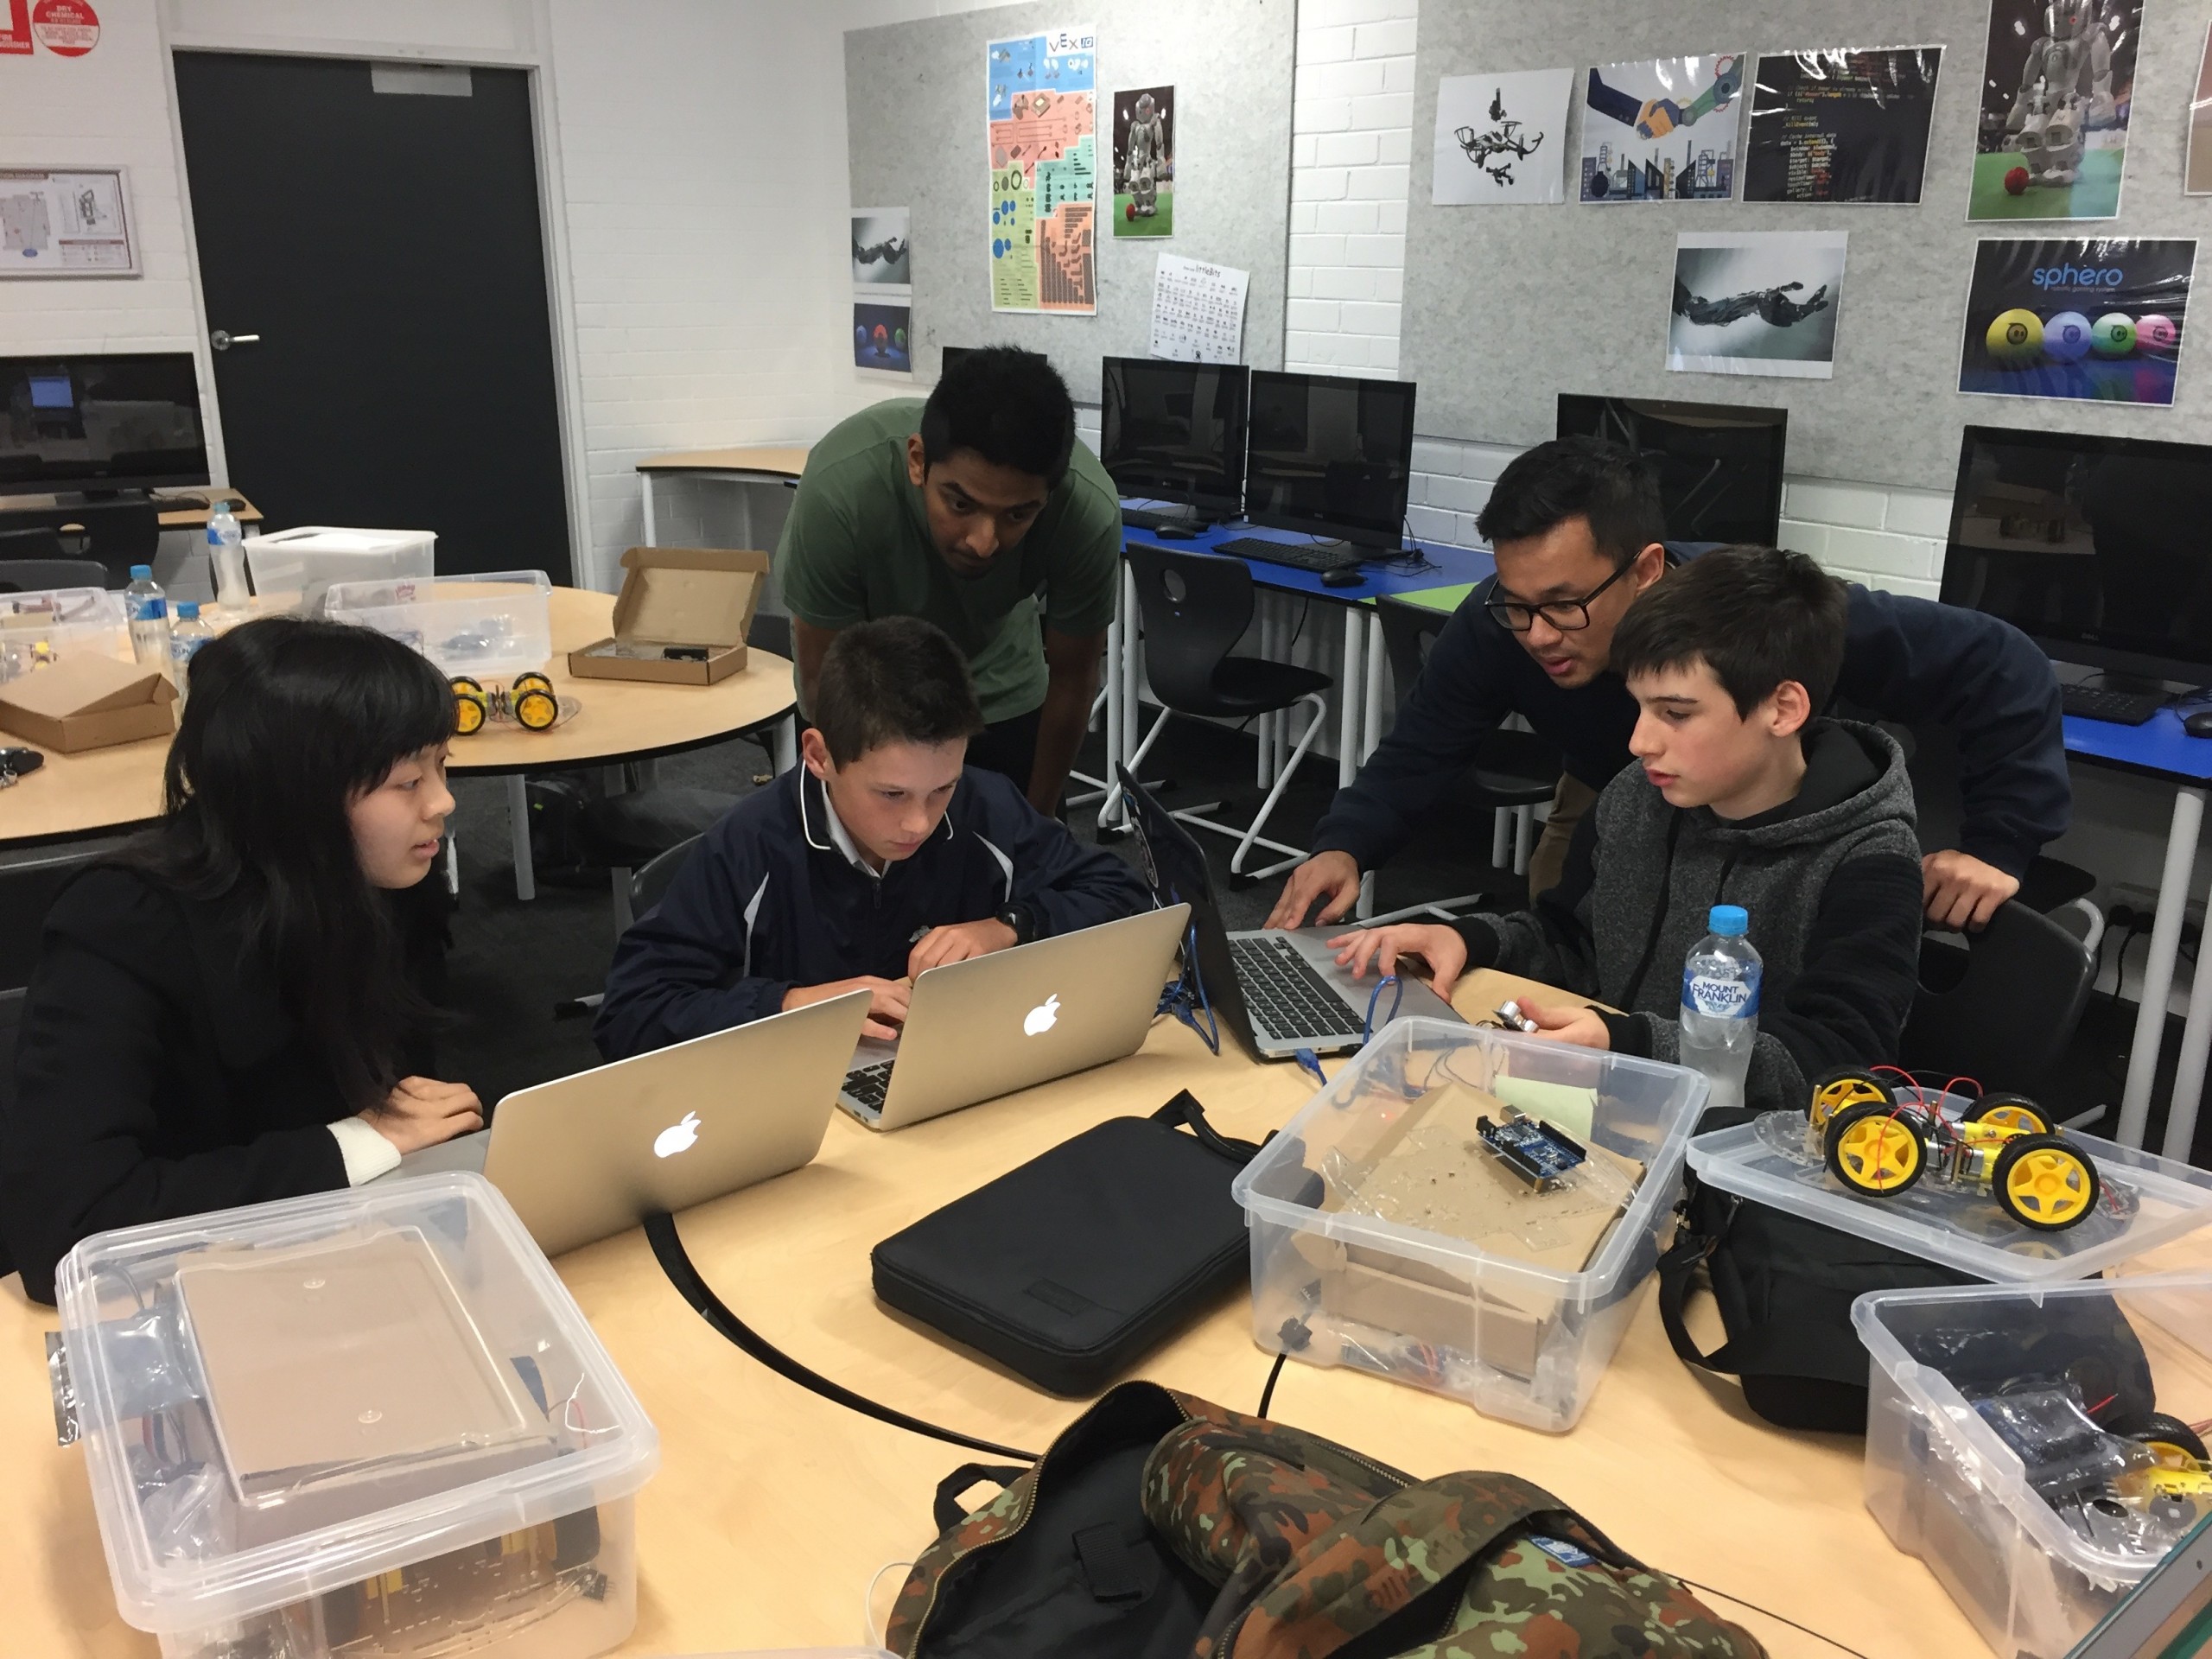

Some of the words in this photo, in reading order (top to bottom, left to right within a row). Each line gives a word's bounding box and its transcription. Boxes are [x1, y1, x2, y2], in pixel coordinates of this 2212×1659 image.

[45, 10, 85, 19] CHEMICAL
[2032, 262, 2123, 291] sphero
[1693, 983, 1747, 1003] FRANKLIN
[1703, 982, 1739, 994] MOUNT
